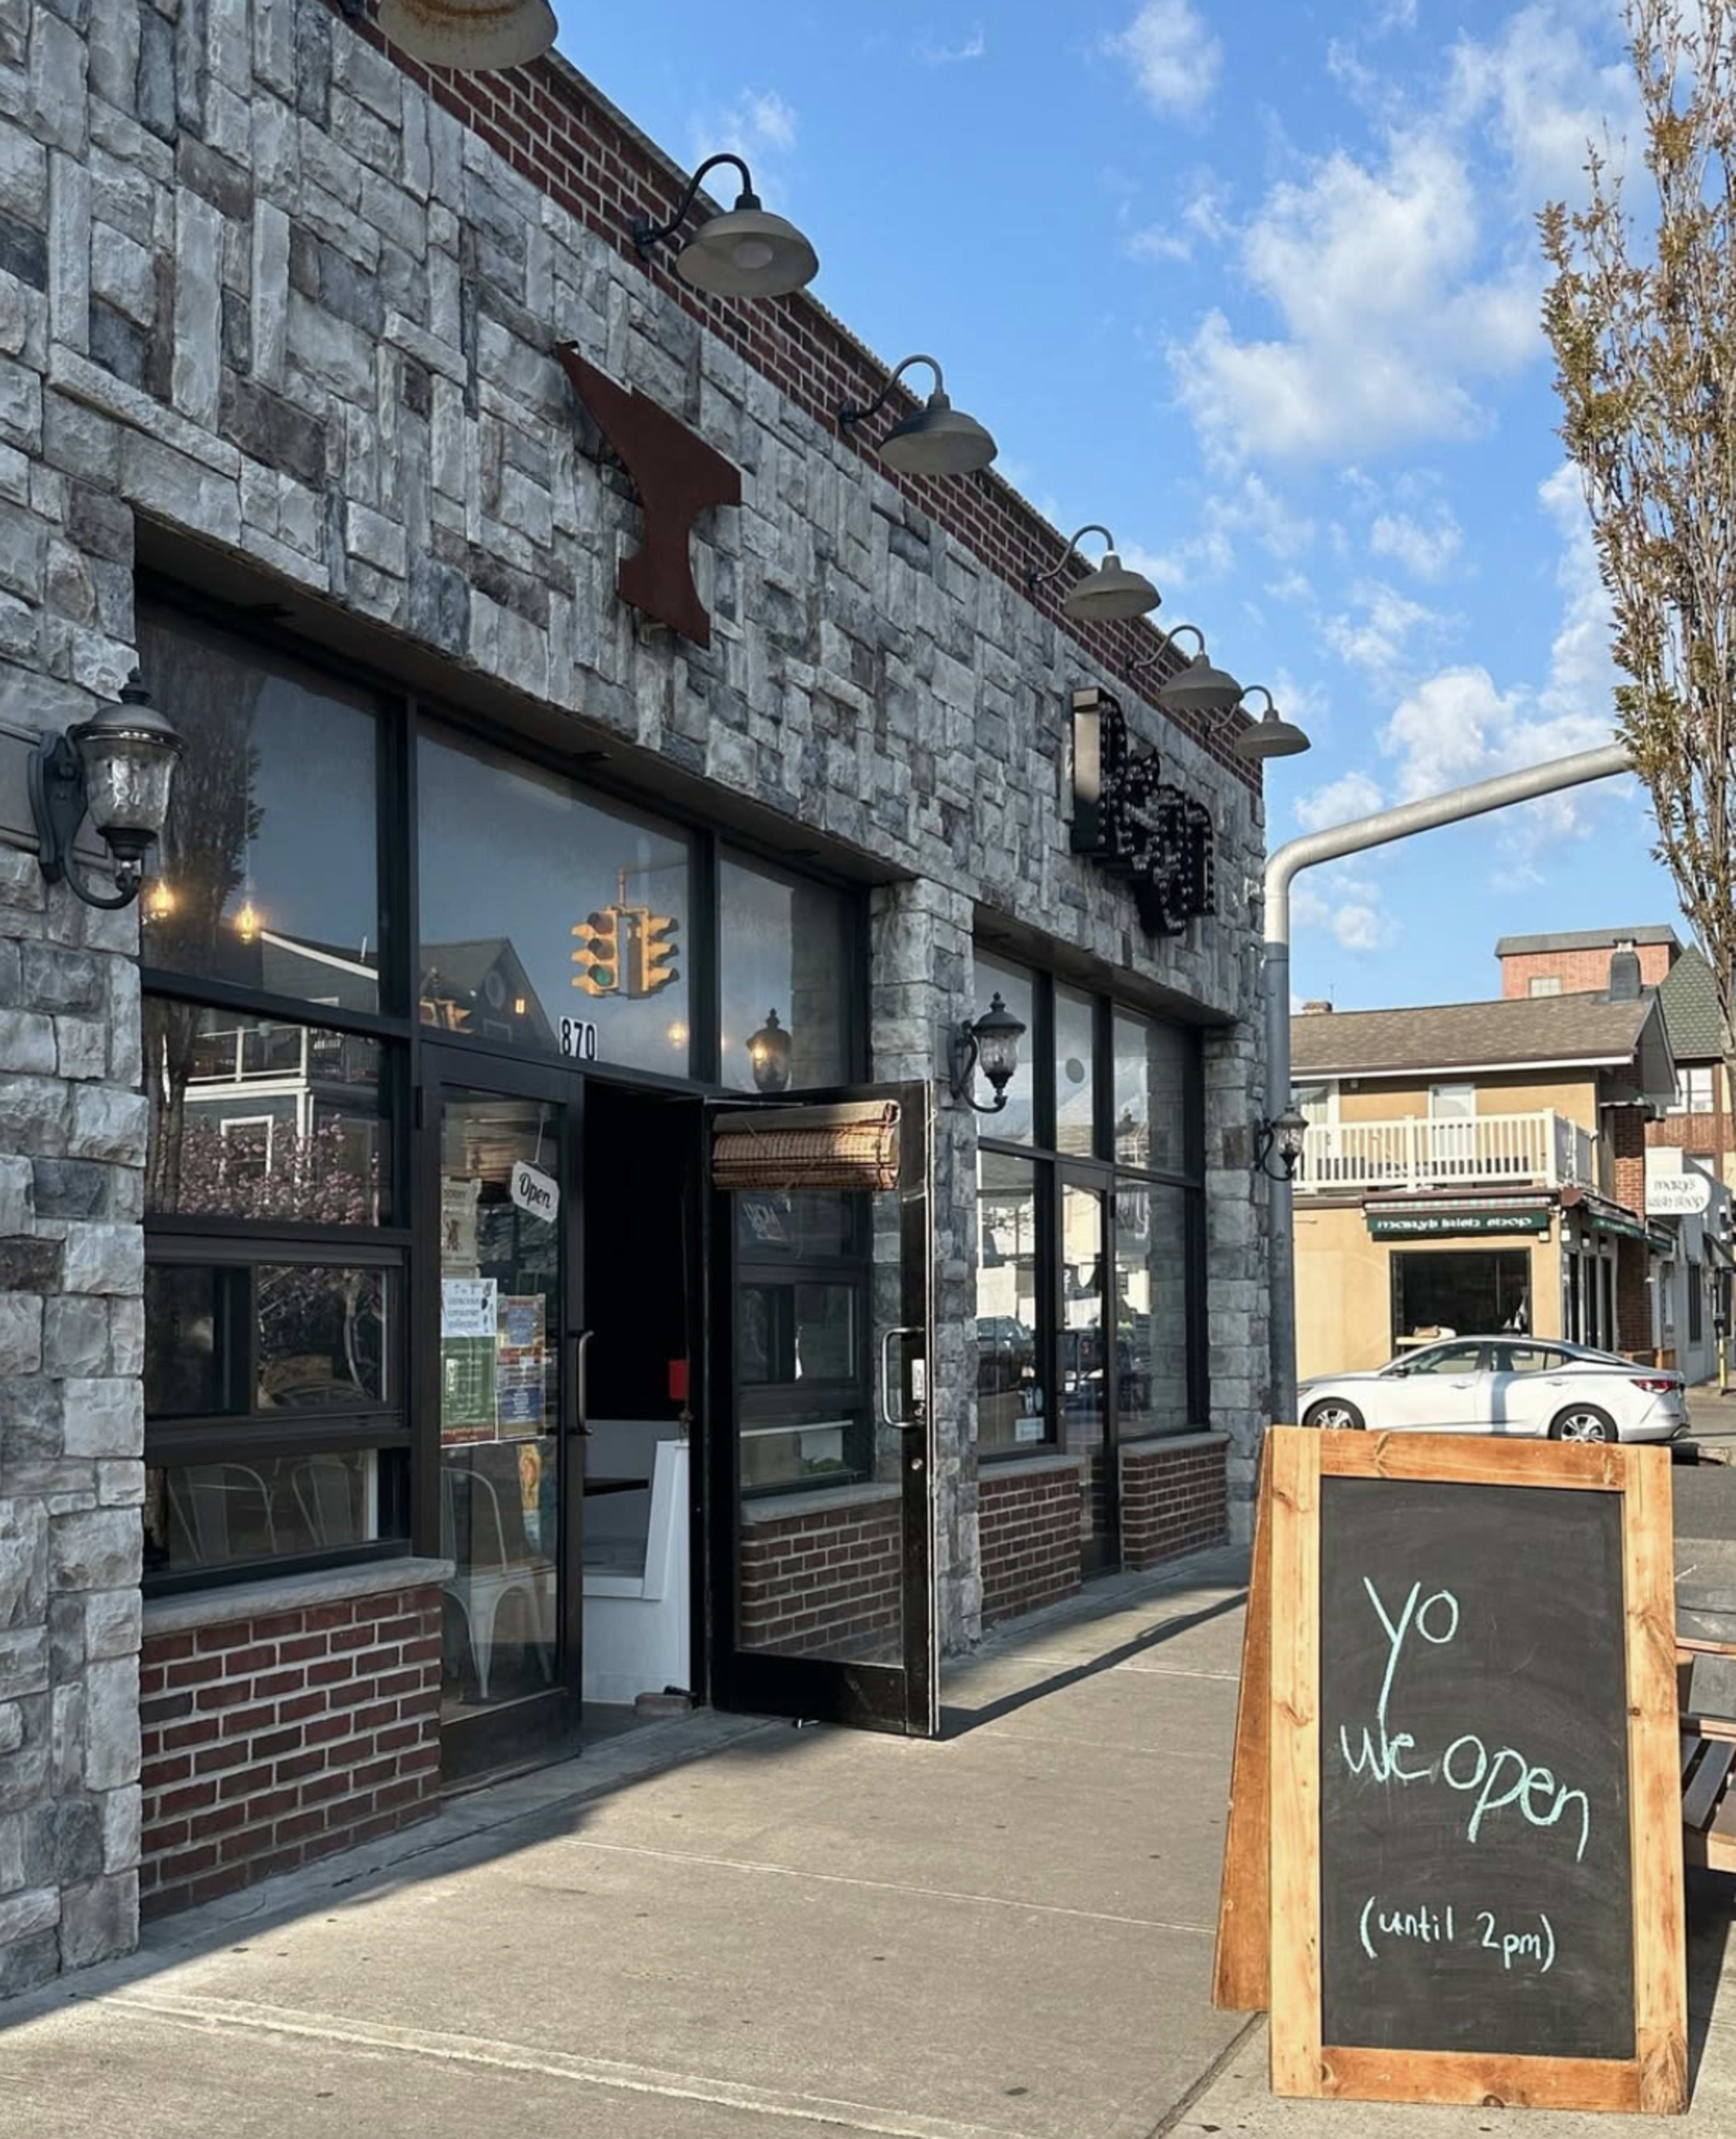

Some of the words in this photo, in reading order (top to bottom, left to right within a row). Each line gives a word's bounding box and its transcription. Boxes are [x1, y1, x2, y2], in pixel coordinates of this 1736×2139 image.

[562, 1018, 595, 1061] 870
[519, 1173, 551, 1209] Open
[1360, 1896, 1454, 1959] (until
[1476, 1912, 1556, 1973] 2pm)
